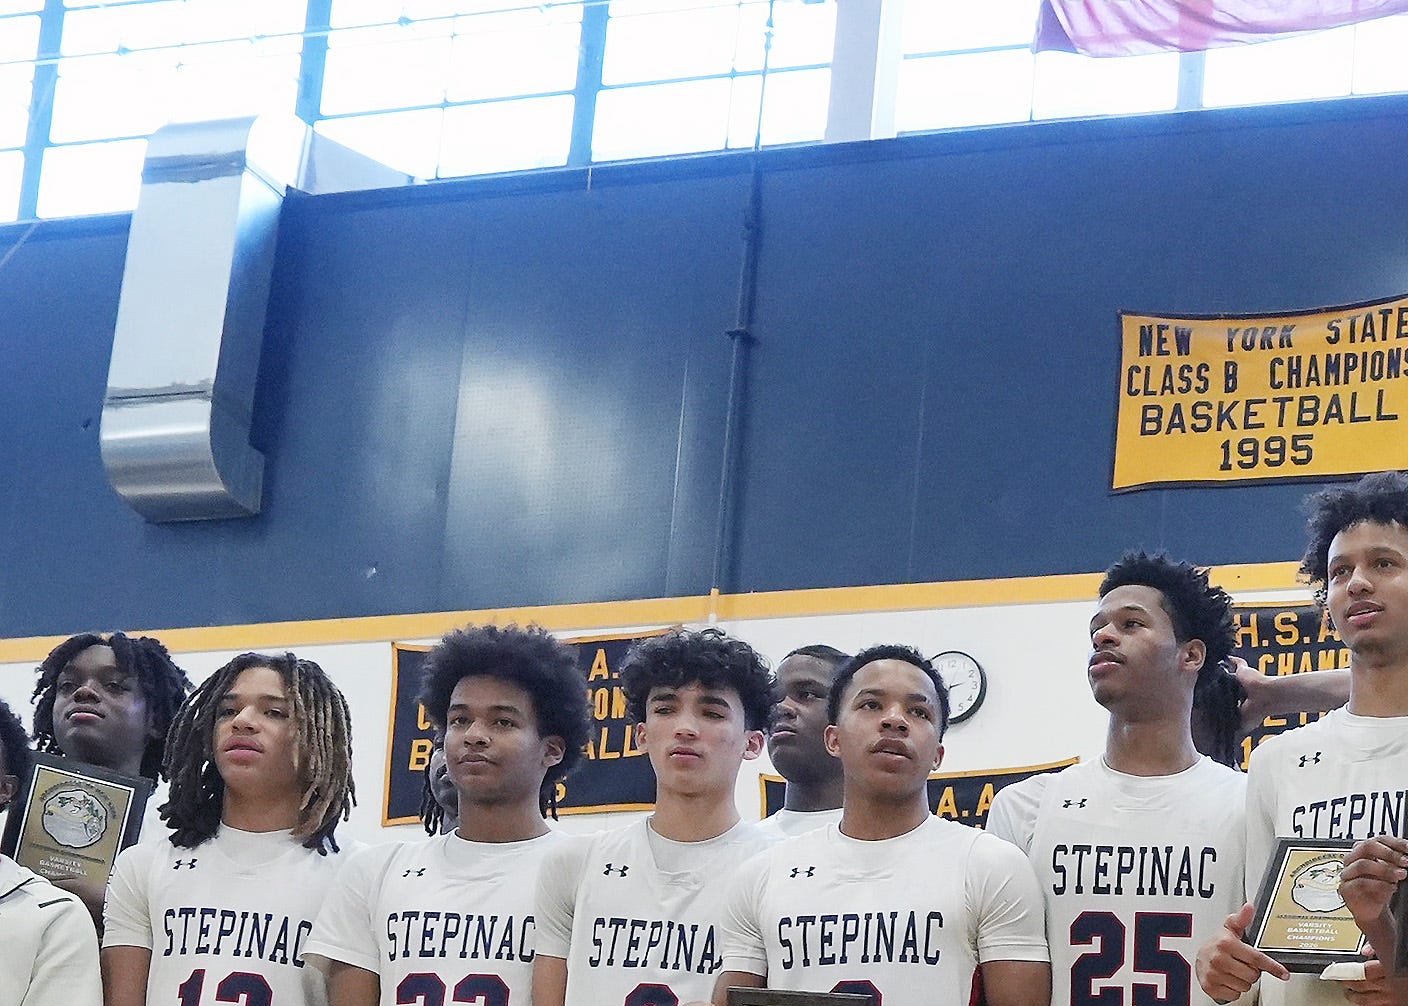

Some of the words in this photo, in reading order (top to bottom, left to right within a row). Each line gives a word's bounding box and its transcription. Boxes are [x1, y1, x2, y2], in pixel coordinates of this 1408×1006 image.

[1138, 326, 1192, 356] NEW
[1227, 324, 1296, 353] YORK
[1127, 362, 1210, 397] CLASS
[1224, 360, 1238, 394] B
[1140, 389, 1398, 436] BASKETBALL
[1220, 434, 1314, 471] 1995
[1052, 845, 1216, 898] STEPINAC
[163, 907, 312, 968] STEPINAC
[387, 911, 536, 962] STEPINAC
[589, 918, 723, 974] STEPINA
[778, 911, 943, 970] STEPINAC
